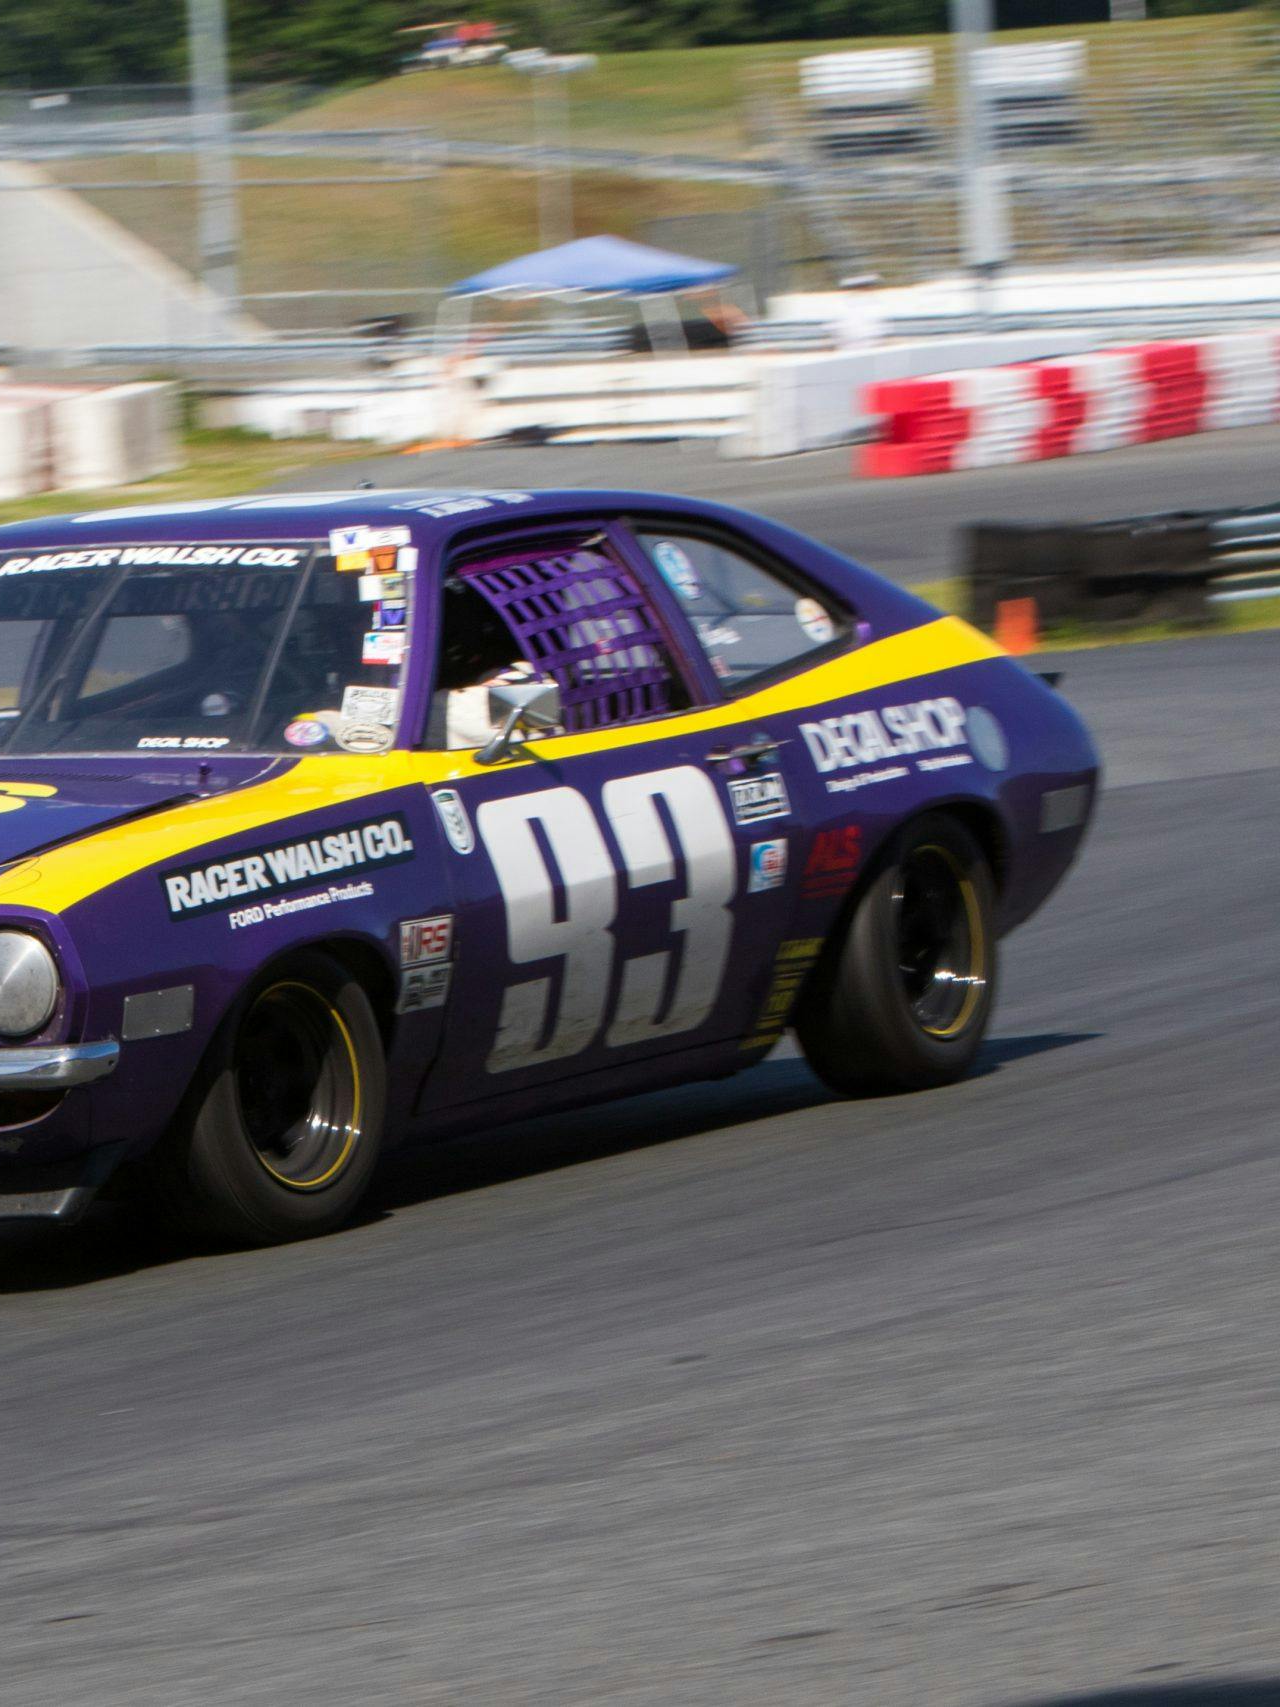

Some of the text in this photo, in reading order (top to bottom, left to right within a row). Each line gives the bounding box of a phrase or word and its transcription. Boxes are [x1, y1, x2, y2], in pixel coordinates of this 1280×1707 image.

[118, 547, 238, 566] WALSH
[236, 548, 301, 567] CO.
[798, 696, 970, 774] DECAL SHOP
[165, 820, 414, 912] RACER WALSH CO.
[228, 881, 375, 930] FORD Performance Products
[476, 764, 738, 1075] 93
